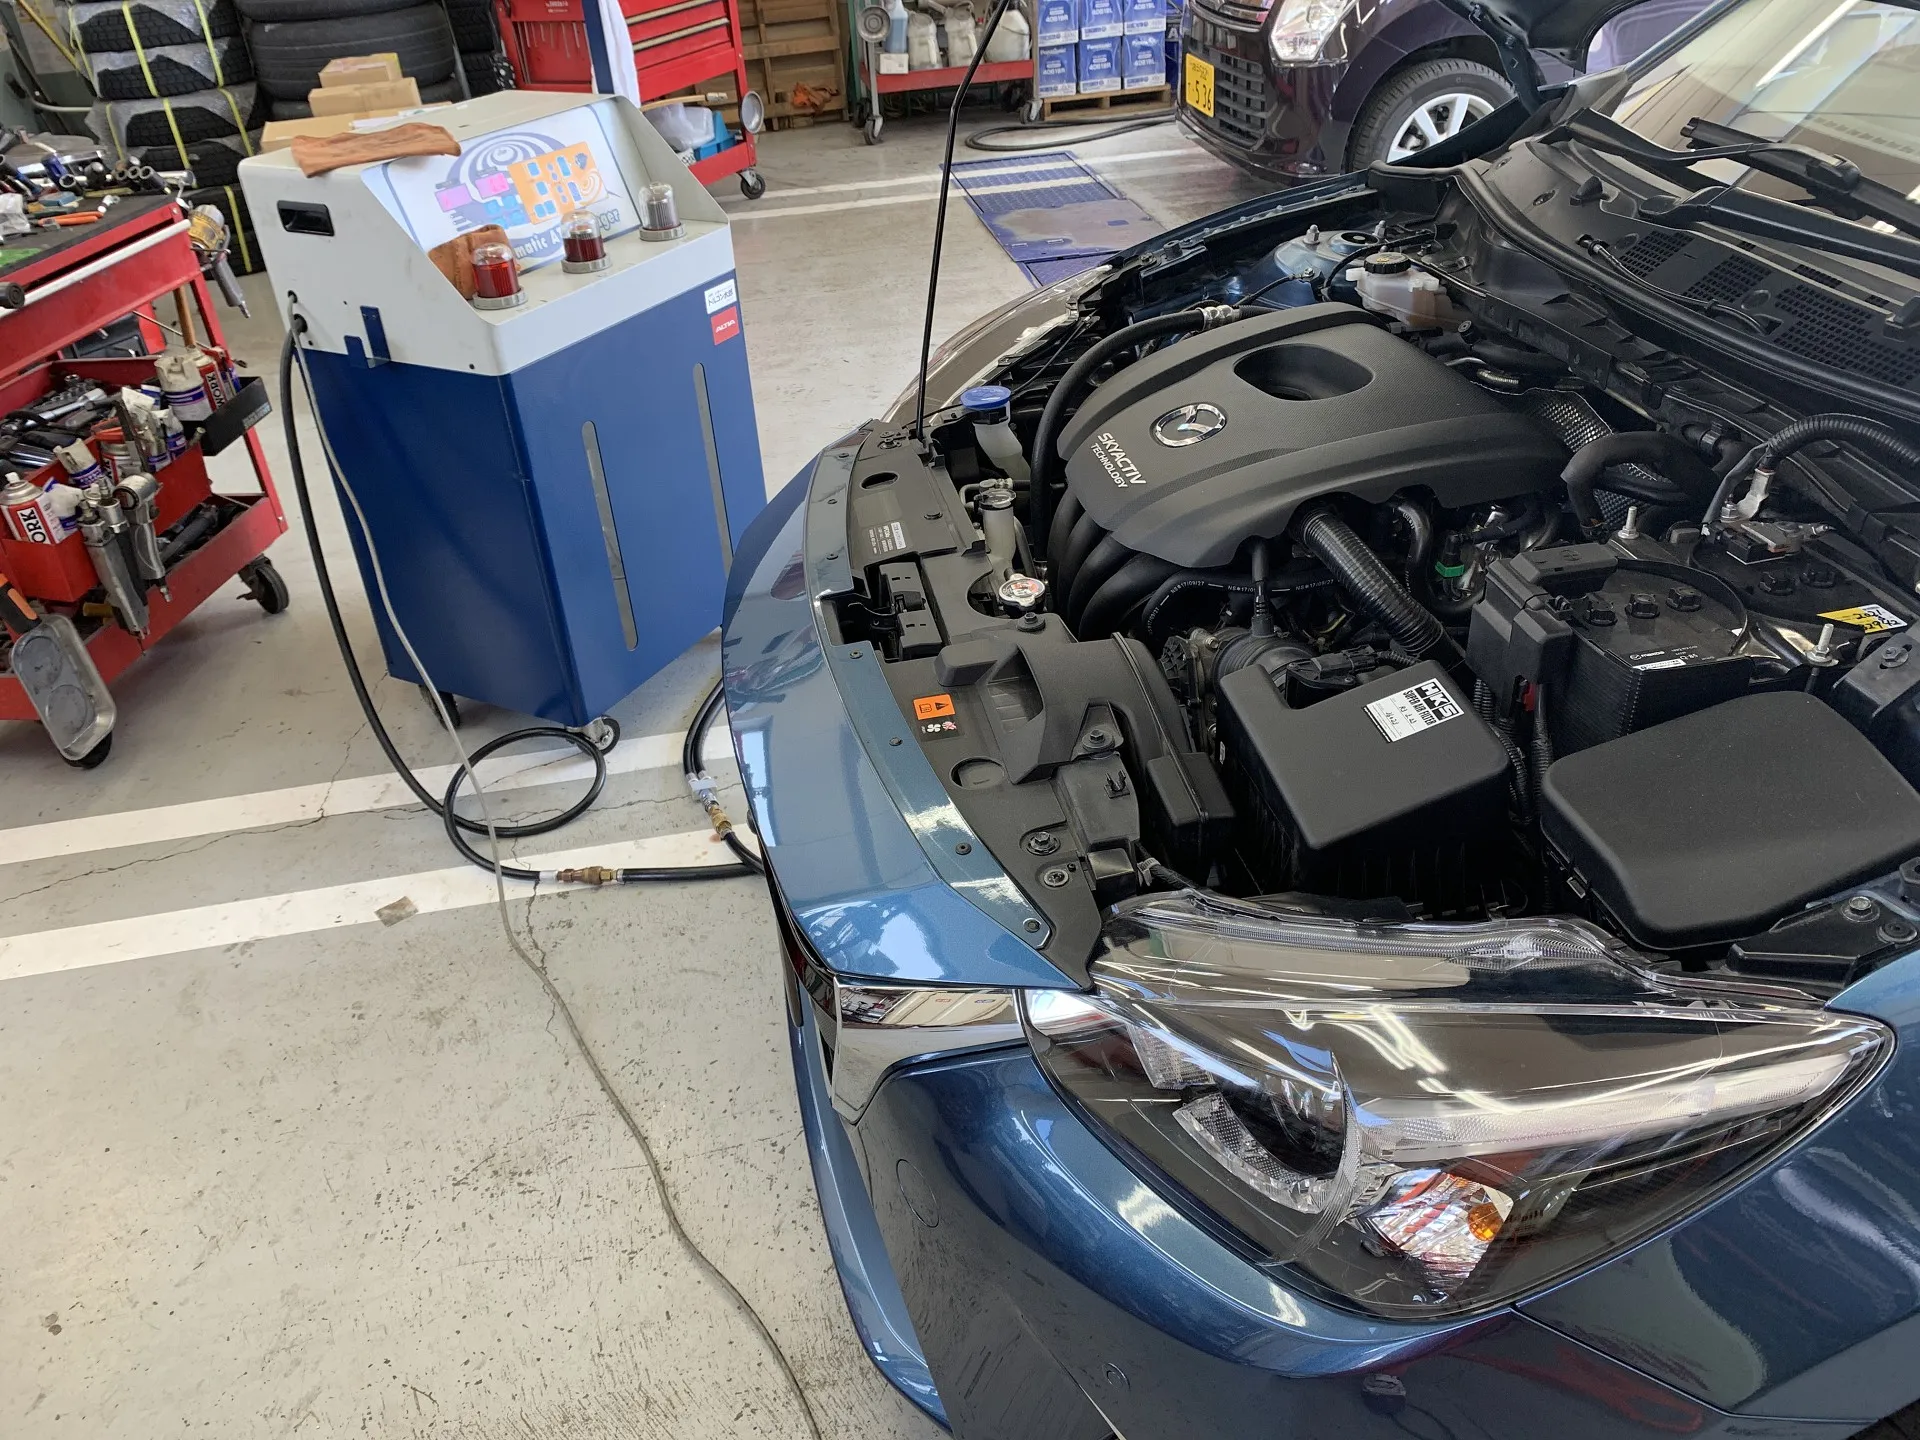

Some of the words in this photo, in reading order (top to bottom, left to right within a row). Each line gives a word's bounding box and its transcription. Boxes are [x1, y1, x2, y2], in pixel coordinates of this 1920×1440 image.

[1090, 443, 1129, 489] TECHNOLOGY
[1097, 432, 1147, 485] SKYACTIV
[20, 508, 46, 543] ORK
[1419, 682, 1459, 718] HKS
